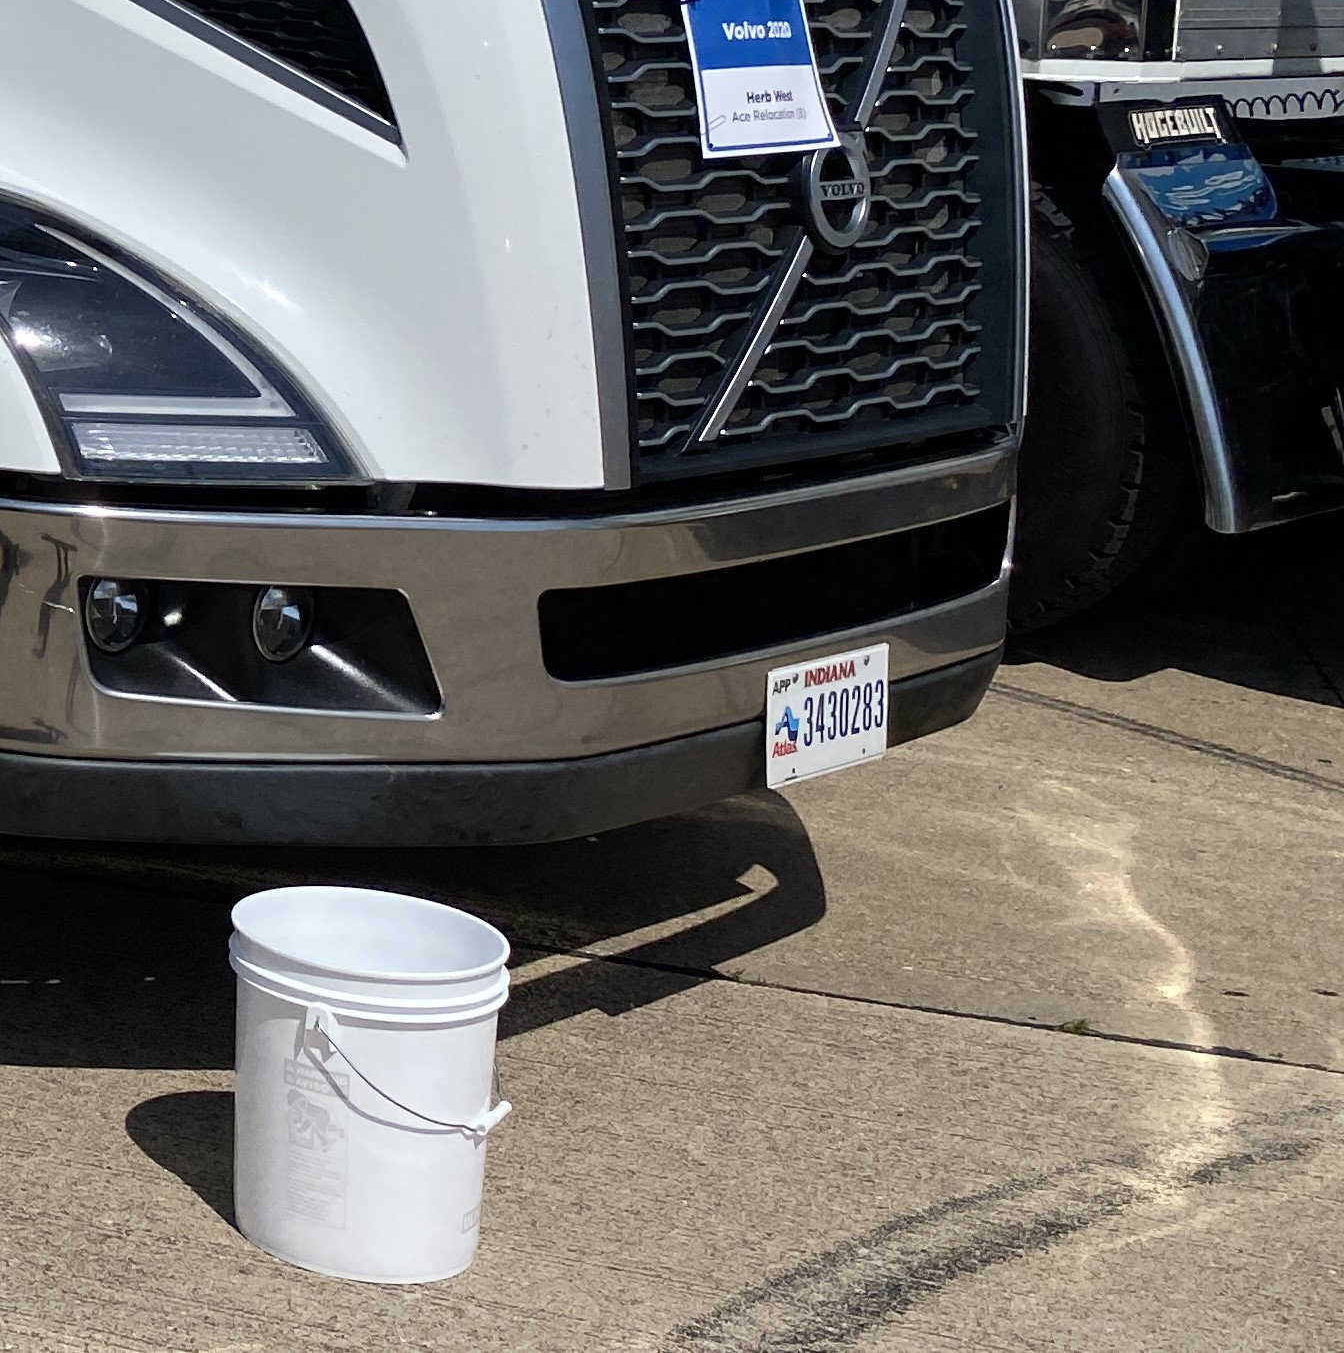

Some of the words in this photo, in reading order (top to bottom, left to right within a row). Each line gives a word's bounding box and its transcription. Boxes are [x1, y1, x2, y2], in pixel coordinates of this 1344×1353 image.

[722, 21, 765, 40] Volvo
[746, 90, 772, 104] Herb
[772, 89, 793, 102] West
[732, 110, 751, 123] Ace
[1131, 107, 1224, 144] HOGEBUILT
[820, 182, 865, 198] VOLVO
[804, 660, 856, 688] INDIANA
[772, 678, 791, 696] APP
[803, 679, 884, 747] 3430283
[772, 738, 798, 758] Atlas
